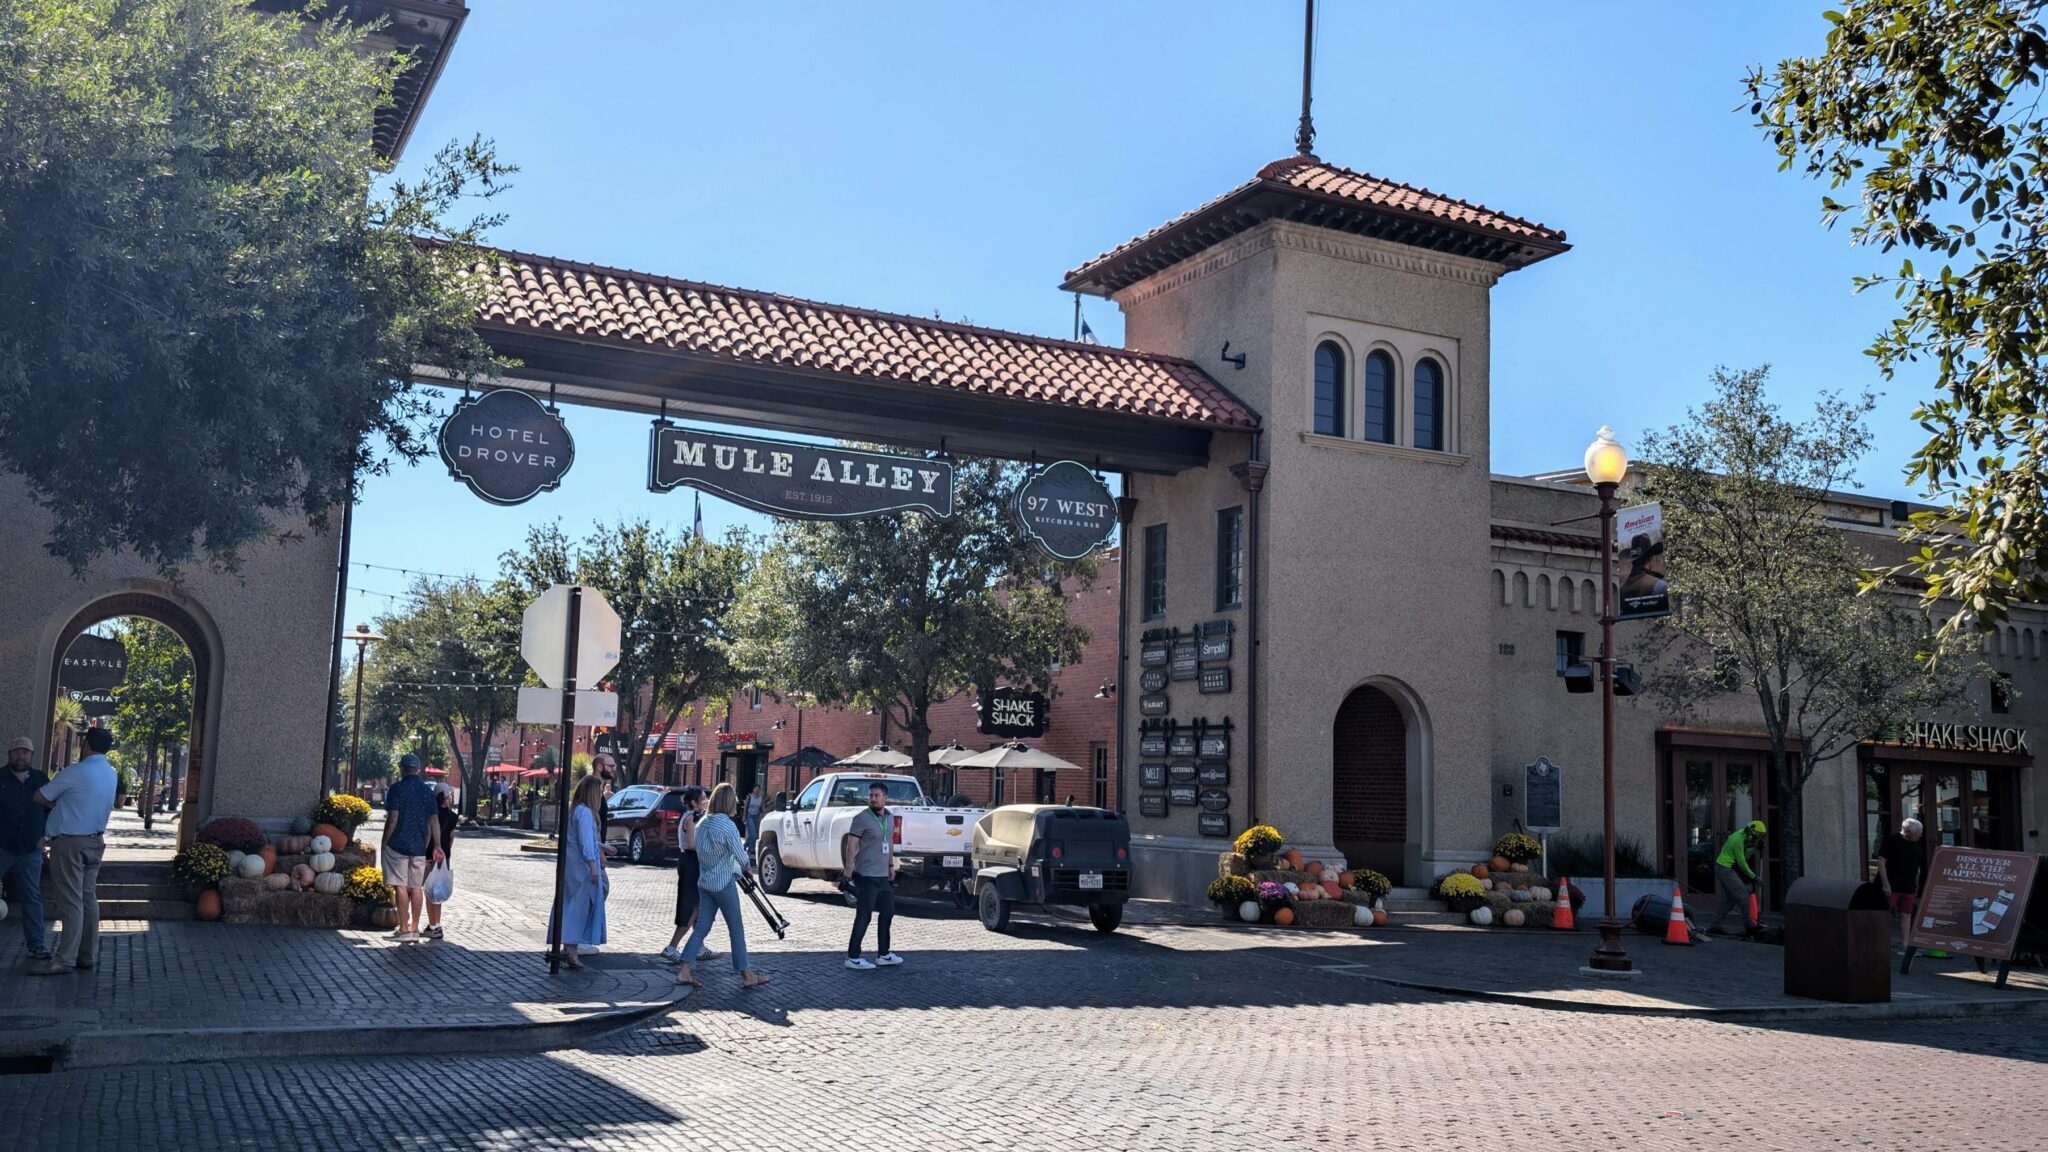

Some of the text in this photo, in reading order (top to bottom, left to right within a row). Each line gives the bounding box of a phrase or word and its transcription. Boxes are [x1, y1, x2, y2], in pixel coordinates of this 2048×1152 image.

[471, 424, 549, 444] HOTEL
[458, 445, 556, 468] DROVER
[673, 439, 941, 494] MULE ALLEY
[810, 493, 833, 505] 1912
[1027, 496, 1108, 518] 97 WEST
[1035, 516, 1100, 529] KITCHEN & BAR
[82, 694, 120, 703] ARIAT
[992, 698, 1034, 714] SHAKE
[991, 712, 1034, 727] SHACK
[1905, 722, 2028, 750] SHAKE SHACK
[1145, 768, 1160, 779] MELT
[1956, 855, 2012, 866] DISCOVER
[1942, 868, 2018, 882] HAPPENINGS!
[1956, 863, 2005, 873] ALL THE
